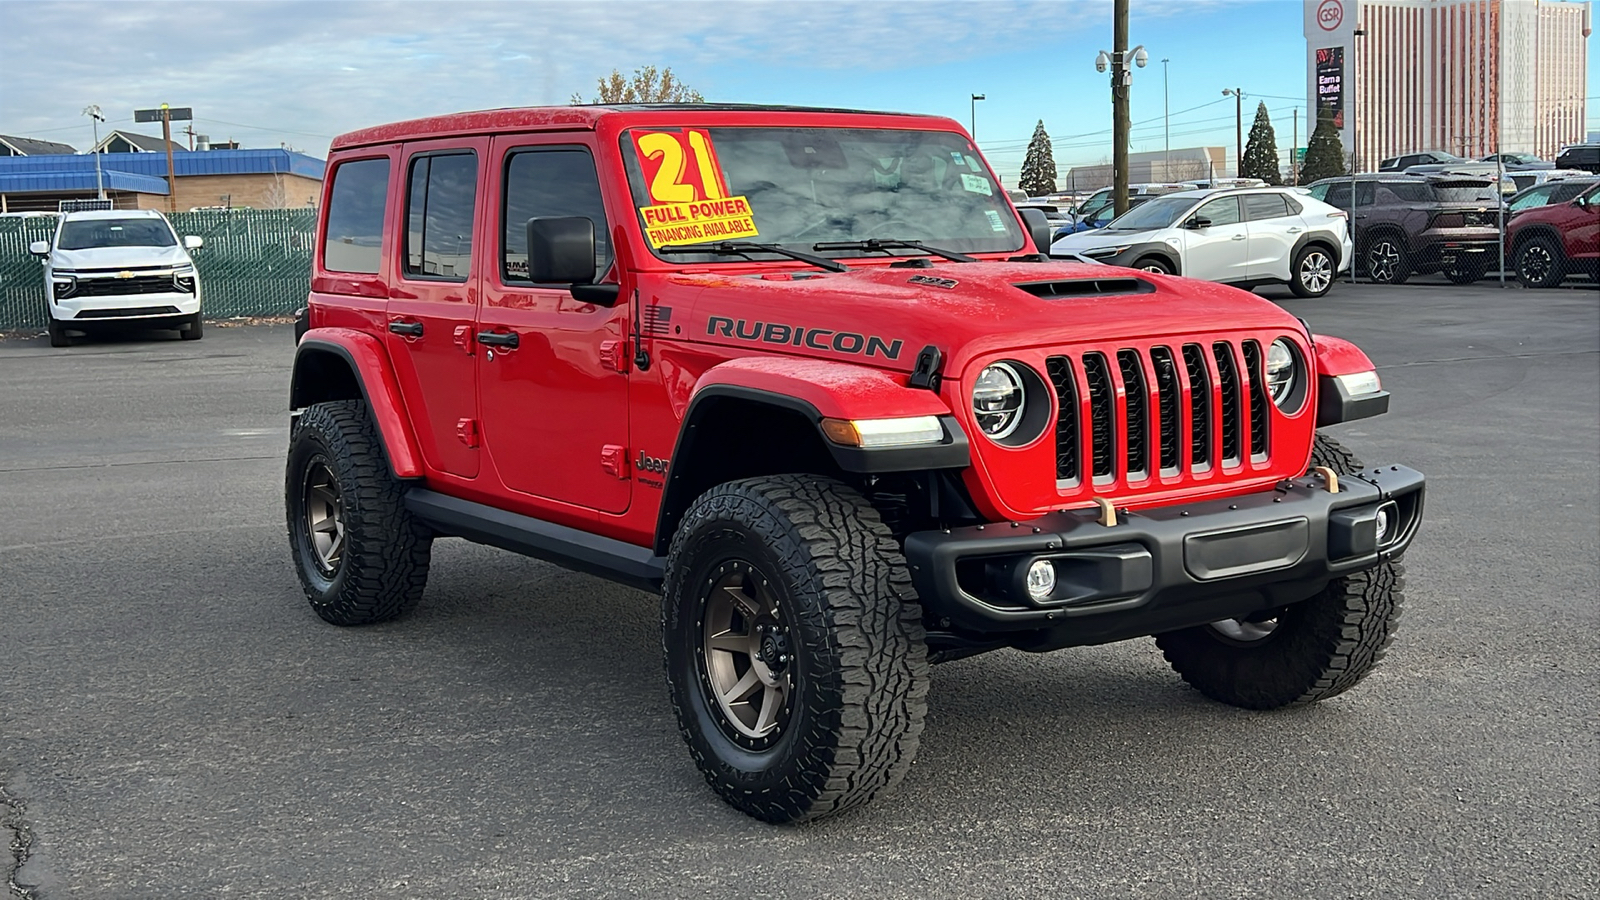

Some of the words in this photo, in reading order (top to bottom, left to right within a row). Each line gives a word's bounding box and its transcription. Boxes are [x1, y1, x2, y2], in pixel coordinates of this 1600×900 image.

[1320, 7, 1340, 22] GSR
[1319, 75, 1335, 84] Earn
[1319, 84, 1340, 94] Buffet
[638, 131, 724, 203] 21
[645, 206, 686, 225] FULL
[690, 199, 747, 218] POWER
[649, 225, 703, 244] FINANCING
[704, 218, 754, 237] AVAILABLE
[707, 316, 903, 360] RUBICON
